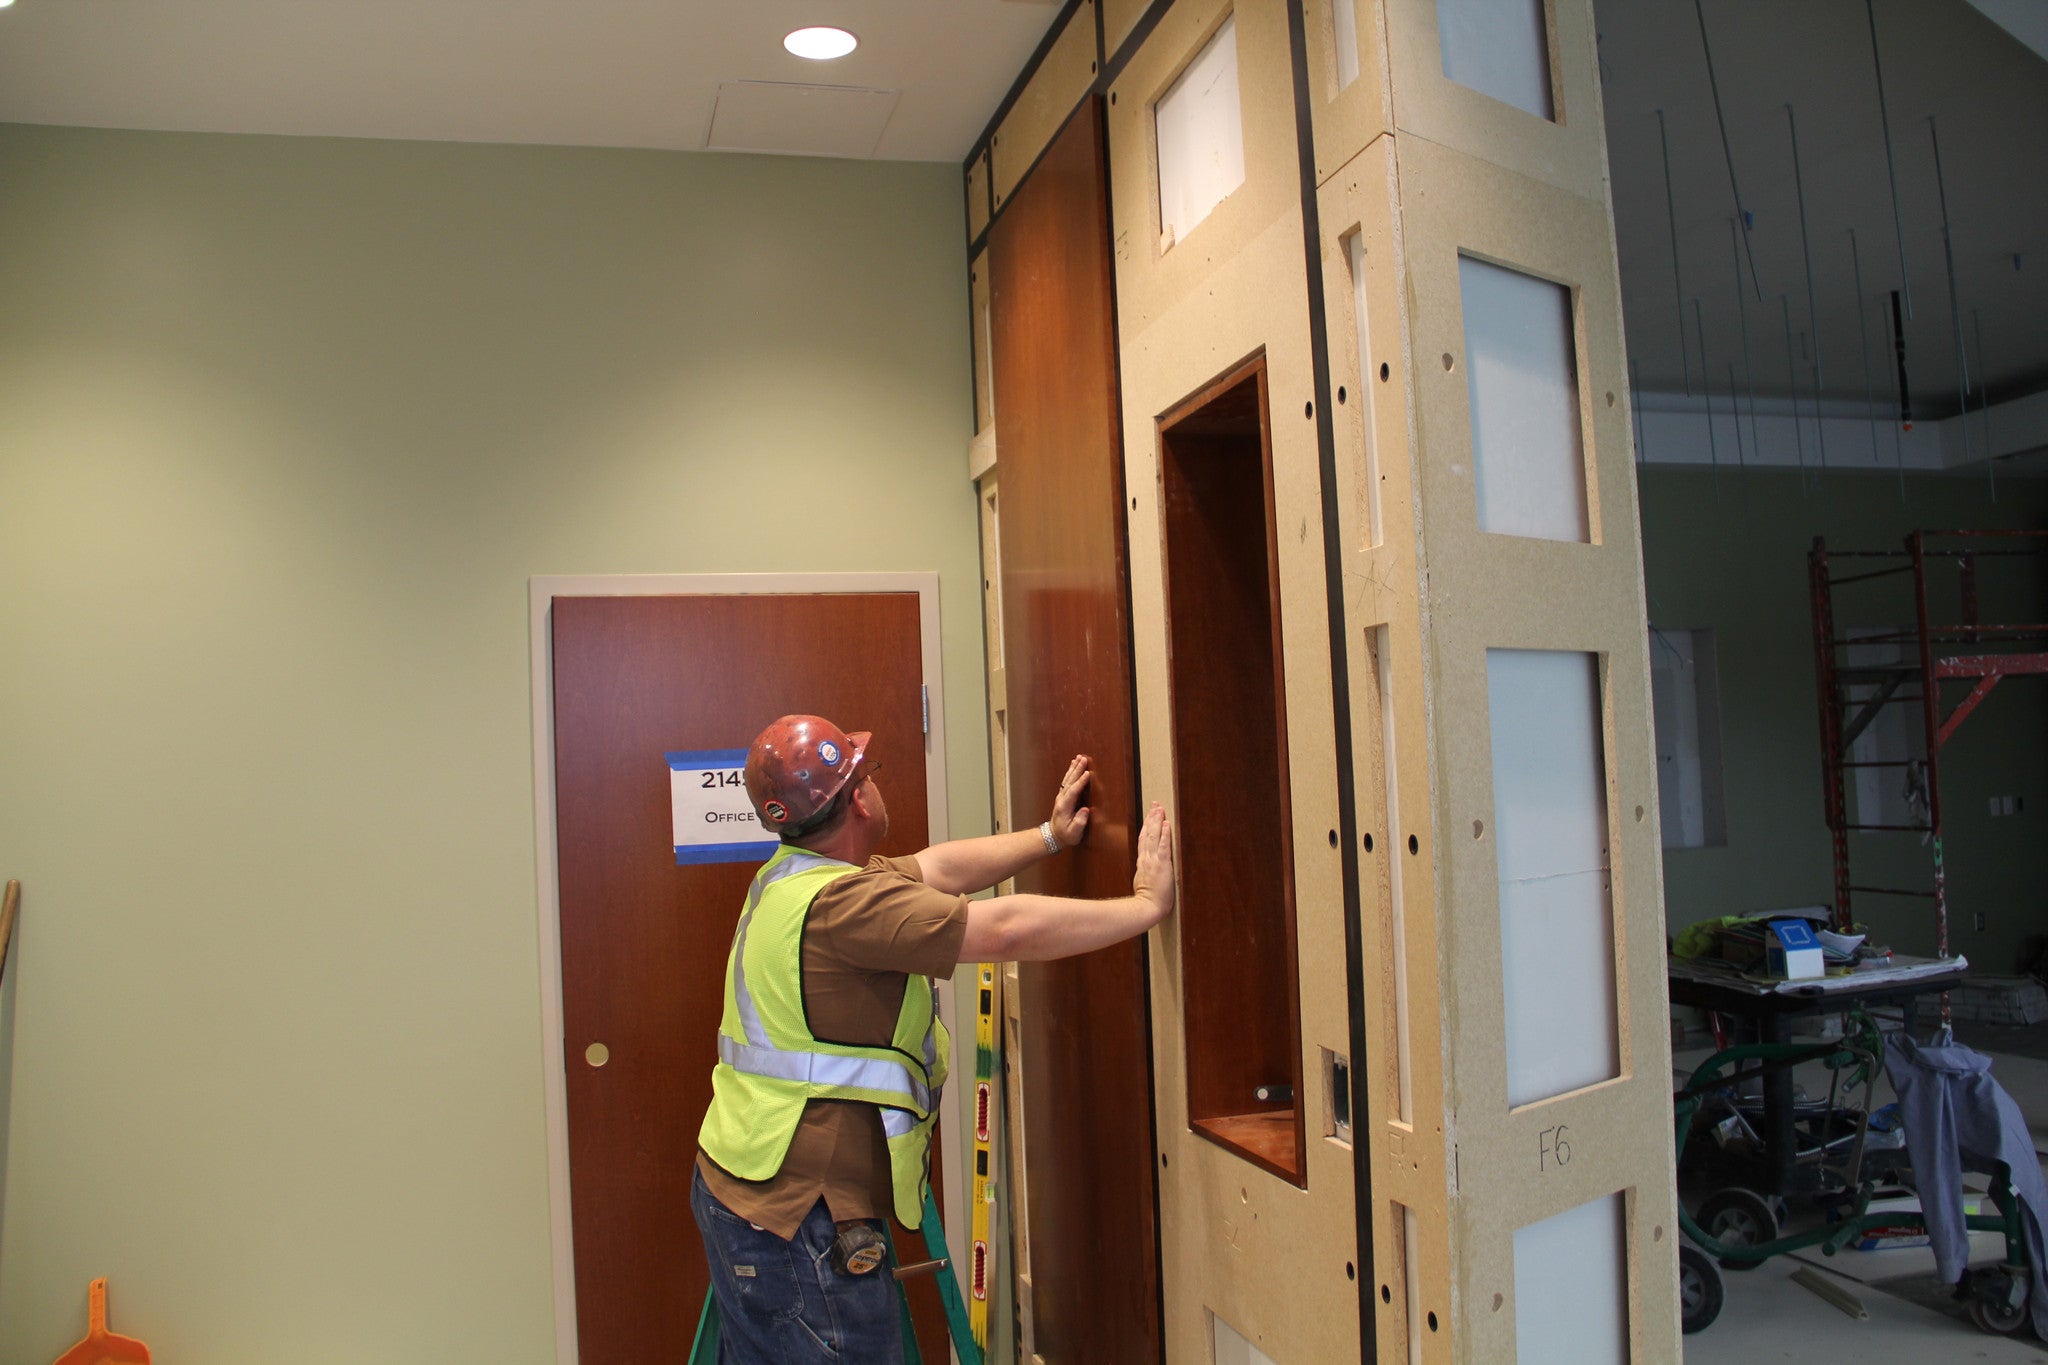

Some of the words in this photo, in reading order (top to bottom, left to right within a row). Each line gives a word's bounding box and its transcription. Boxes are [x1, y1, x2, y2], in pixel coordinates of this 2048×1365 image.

[701, 770, 746, 788] 214
[704, 811, 755, 823] OFFICE
[1539, 1125, 1571, 1172] F6
